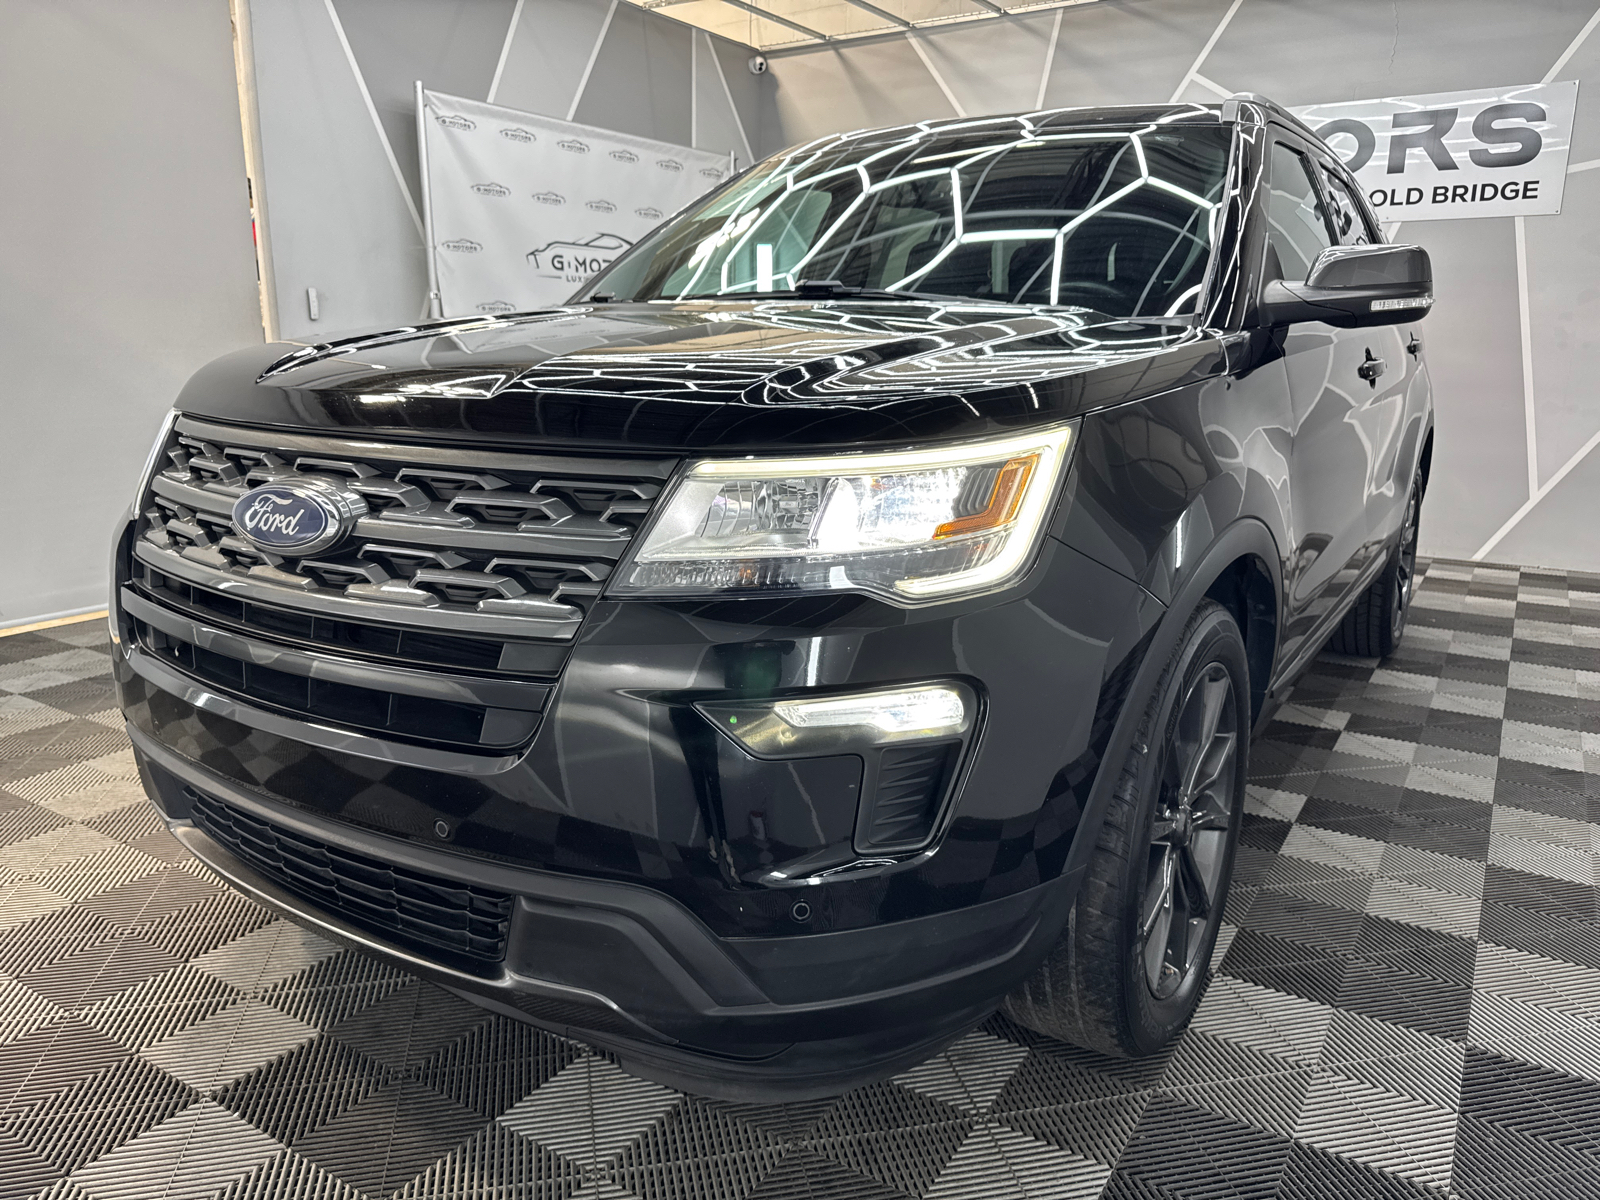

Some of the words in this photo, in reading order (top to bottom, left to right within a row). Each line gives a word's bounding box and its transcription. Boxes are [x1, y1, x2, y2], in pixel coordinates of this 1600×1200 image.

[1369, 187, 1424, 207] OLD
[1431, 180, 1540, 204] BRIDGE
[244, 493, 305, 536] Ford
